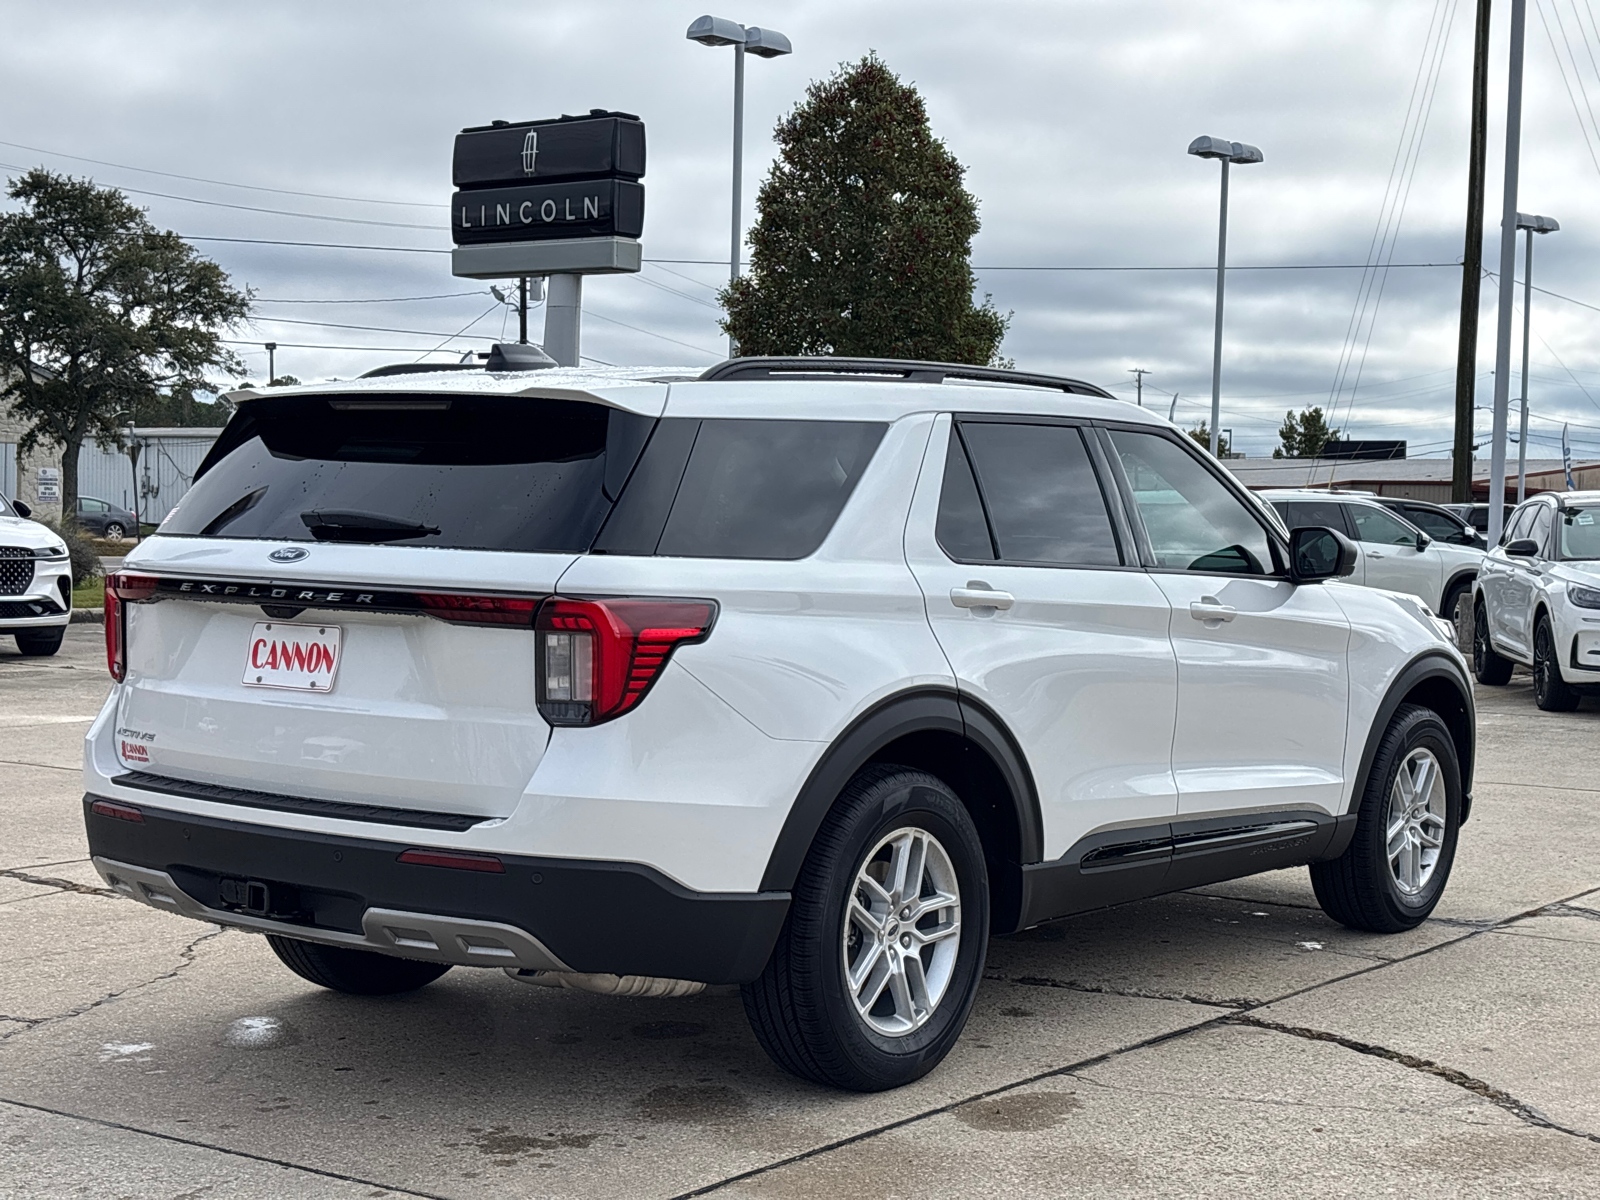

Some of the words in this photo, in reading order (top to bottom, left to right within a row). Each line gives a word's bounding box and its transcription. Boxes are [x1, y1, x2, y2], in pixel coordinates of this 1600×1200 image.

[462, 196, 599, 228] LINCOLN
[274, 548, 301, 558] Ford
[180, 582, 374, 603] EXPLORER
[251, 638, 337, 674] CANNON
[117, 727, 156, 741] ACTIVE
